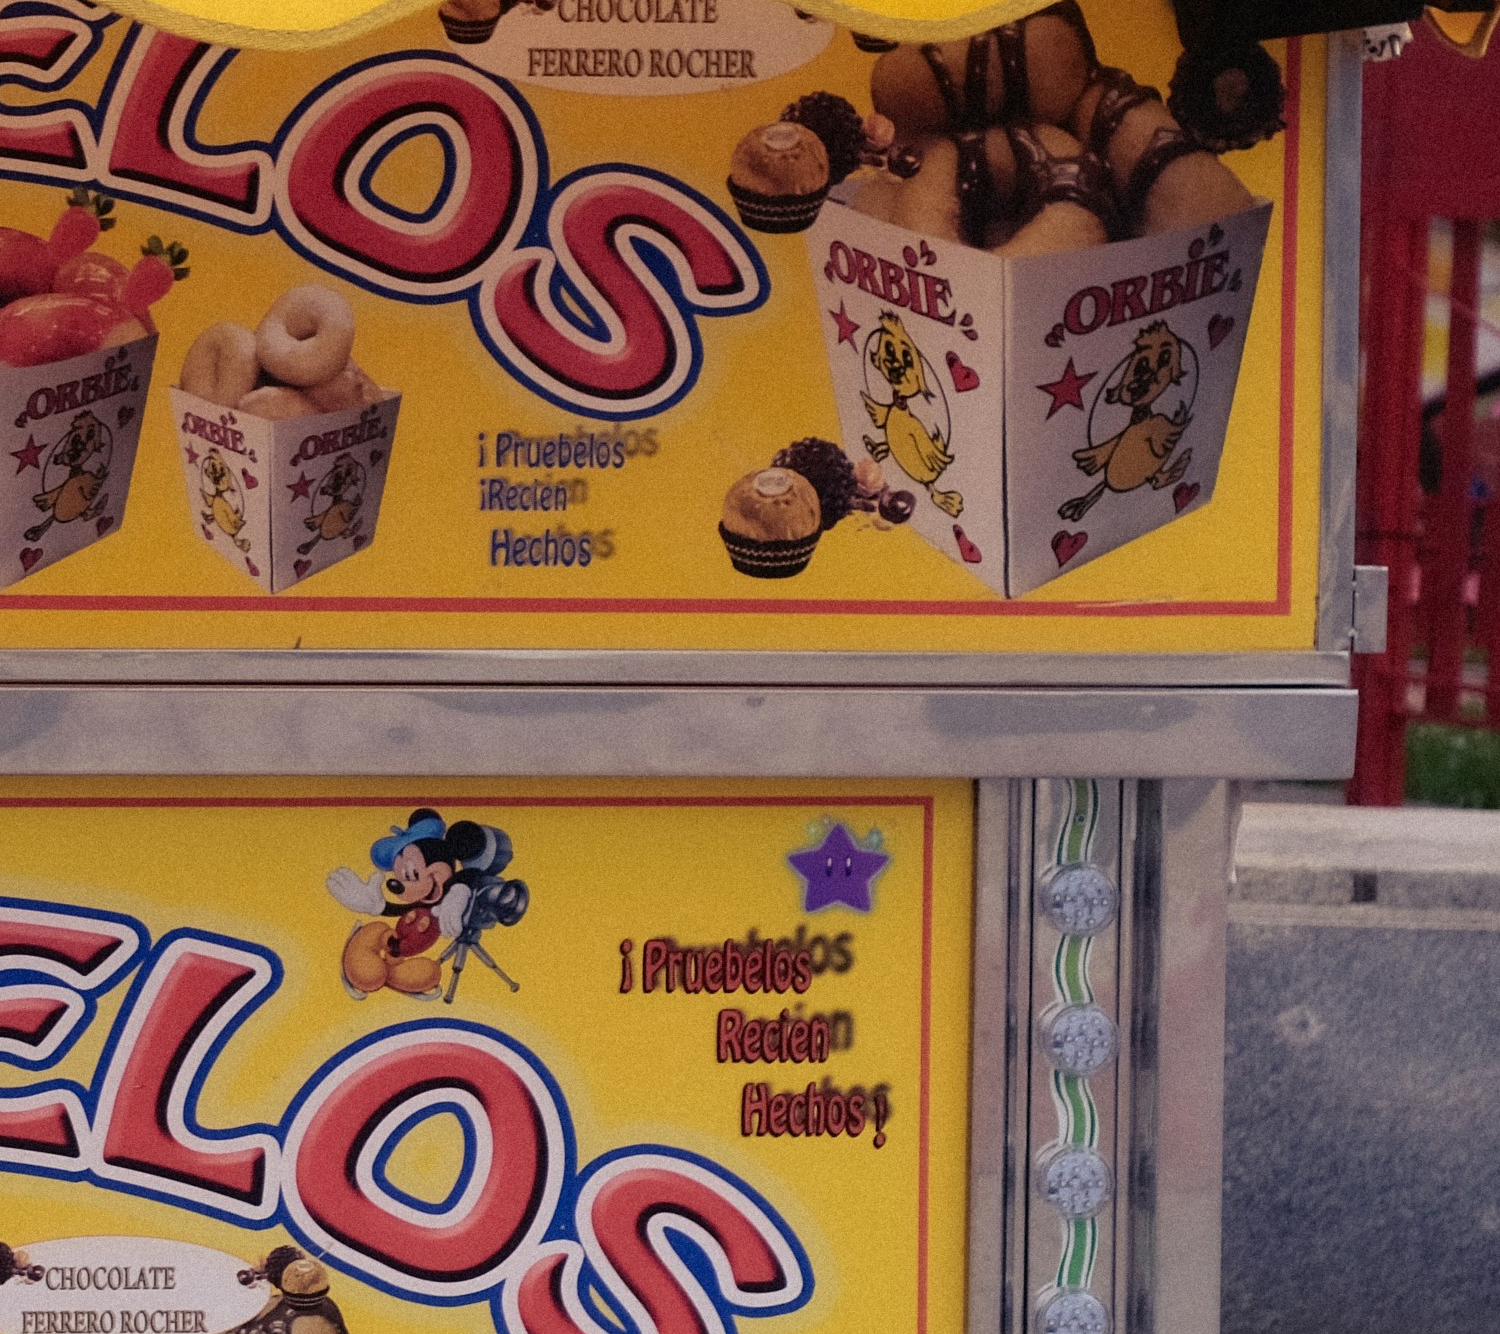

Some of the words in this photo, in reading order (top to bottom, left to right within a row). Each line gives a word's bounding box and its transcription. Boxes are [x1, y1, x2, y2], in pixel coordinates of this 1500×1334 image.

[528, 48, 644, 78] FERRERO
[651, 48, 757, 79] ROCHER
[829, 240, 956, 326] ORBIE
[1063, 238, 1229, 335] ORBIE
[494, 432, 626, 468] Pruebelos
[490, 529, 592, 567] Hechos
[642, 937, 813, 995] Pruebelos
[45, 1266, 176, 1291] CHOCOLATE
[21, 1310, 114, 1334] FERRERO
[119, 1309, 209, 1334] ROCHER
